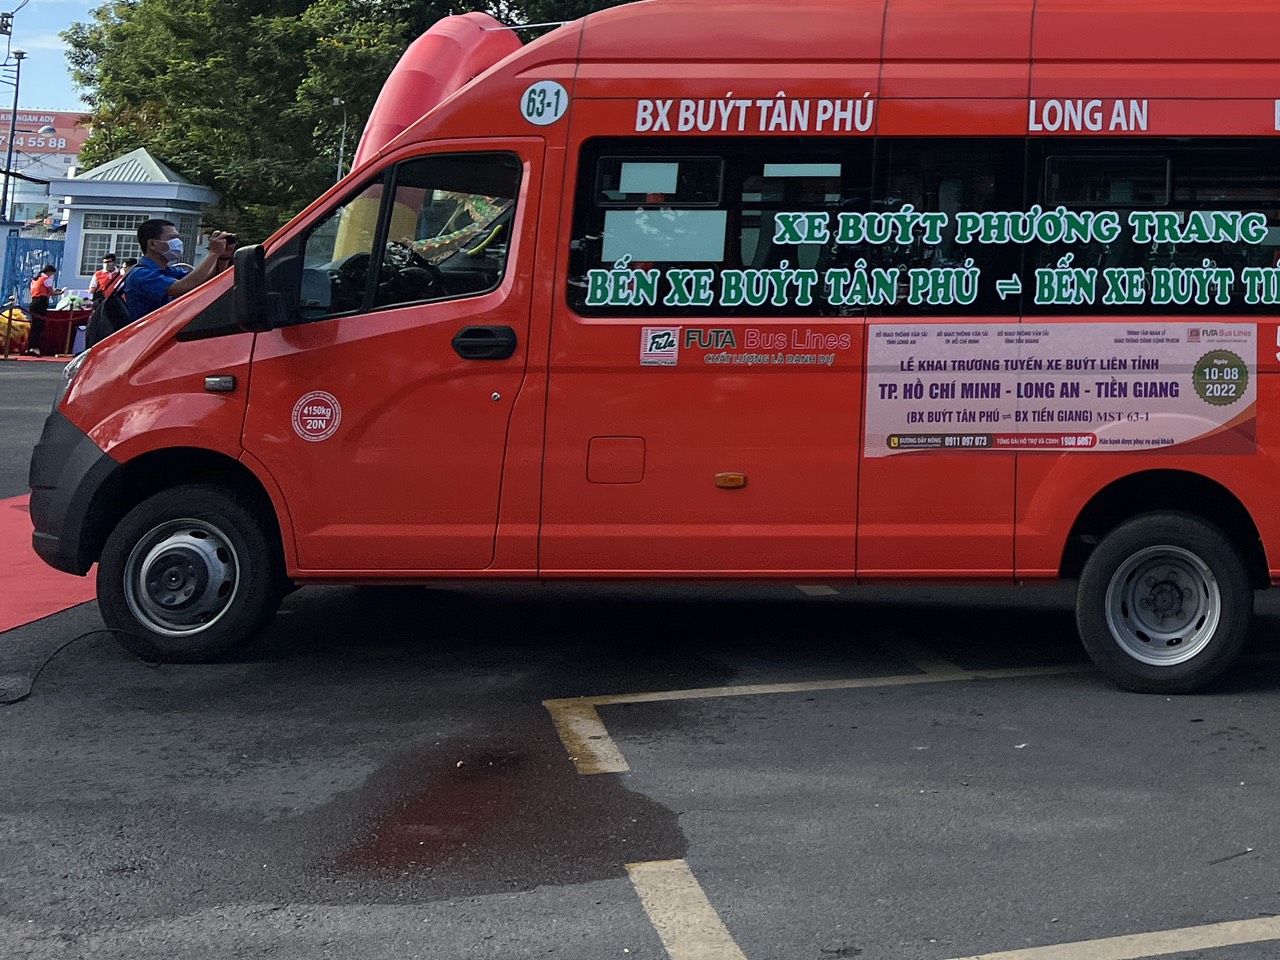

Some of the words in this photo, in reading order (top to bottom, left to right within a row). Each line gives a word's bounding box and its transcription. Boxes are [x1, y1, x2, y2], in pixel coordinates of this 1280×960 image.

[526, 87, 561, 118] 63-1
[635, 99, 673, 132] BX
[677, 91, 752, 132] BUÝT
[756, 91, 809, 132] TÂN
[815, 91, 874, 132] PHÚ
[1029, 99, 1102, 132] LONG
[1108, 99, 1148, 132] AN
[28, 138, 46, 147] 55
[48, 138, 66, 149] 88
[772, 211, 830, 245] XE
[836, 204, 947, 245] BUÝT
[954, 204, 1121, 245] PHƯƠNG
[1129, 210, 1268, 244] TRANG
[585, 253, 660, 306] BẾN
[663, 268, 714, 306] XE
[825, 258, 901, 306] TÂN
[1034, 252, 1097, 305] BẾN
[1102, 268, 1145, 305] XE
[684, 328, 737, 349] FUTA
[744, 329, 788, 350] Bus
[791, 328, 851, 350] Lines
[786, 354, 817, 364] DANH
[918, 360, 947, 371] KHAI
[950, 358, 1000, 371] TRƯƠNG
[1004, 356, 1042, 371] TUYẾN
[1046, 359, 1062, 371] XE
[1066, 357, 1096, 371] BUÝT
[1100, 357, 1127, 370] LIÊN
[1131, 355, 1159, 370] TỈNH
[1203, 367, 1239, 380] 10-08
[879, 383, 898, 400] TP.
[903, 378, 924, 400] HỒ
[929, 381, 956, 400] CHÍ
[961, 382, 1001, 399] MINH
[1016, 382, 1055, 399] LONG
[1059, 382, 1080, 399] AN
[1095, 377, 1128, 399] TIỀN
[1133, 381, 1180, 399] GIANG
[1205, 384, 1236, 397] 2022
[303, 406, 331, 417] 4150kg
[907, 411, 924, 425] (BX
[927, 409, 953, 424] BUÝT
[956, 409, 976, 423] TÂN
[979, 409, 999, 423] PHÚ
[1015, 411, 1029, 422] BX
[1057, 411, 1093, 423] GIANG)
[1097, 412, 1124, 422] MST
[1127, 412, 1150, 422] 63-1
[306, 419, 326, 429] 20N
